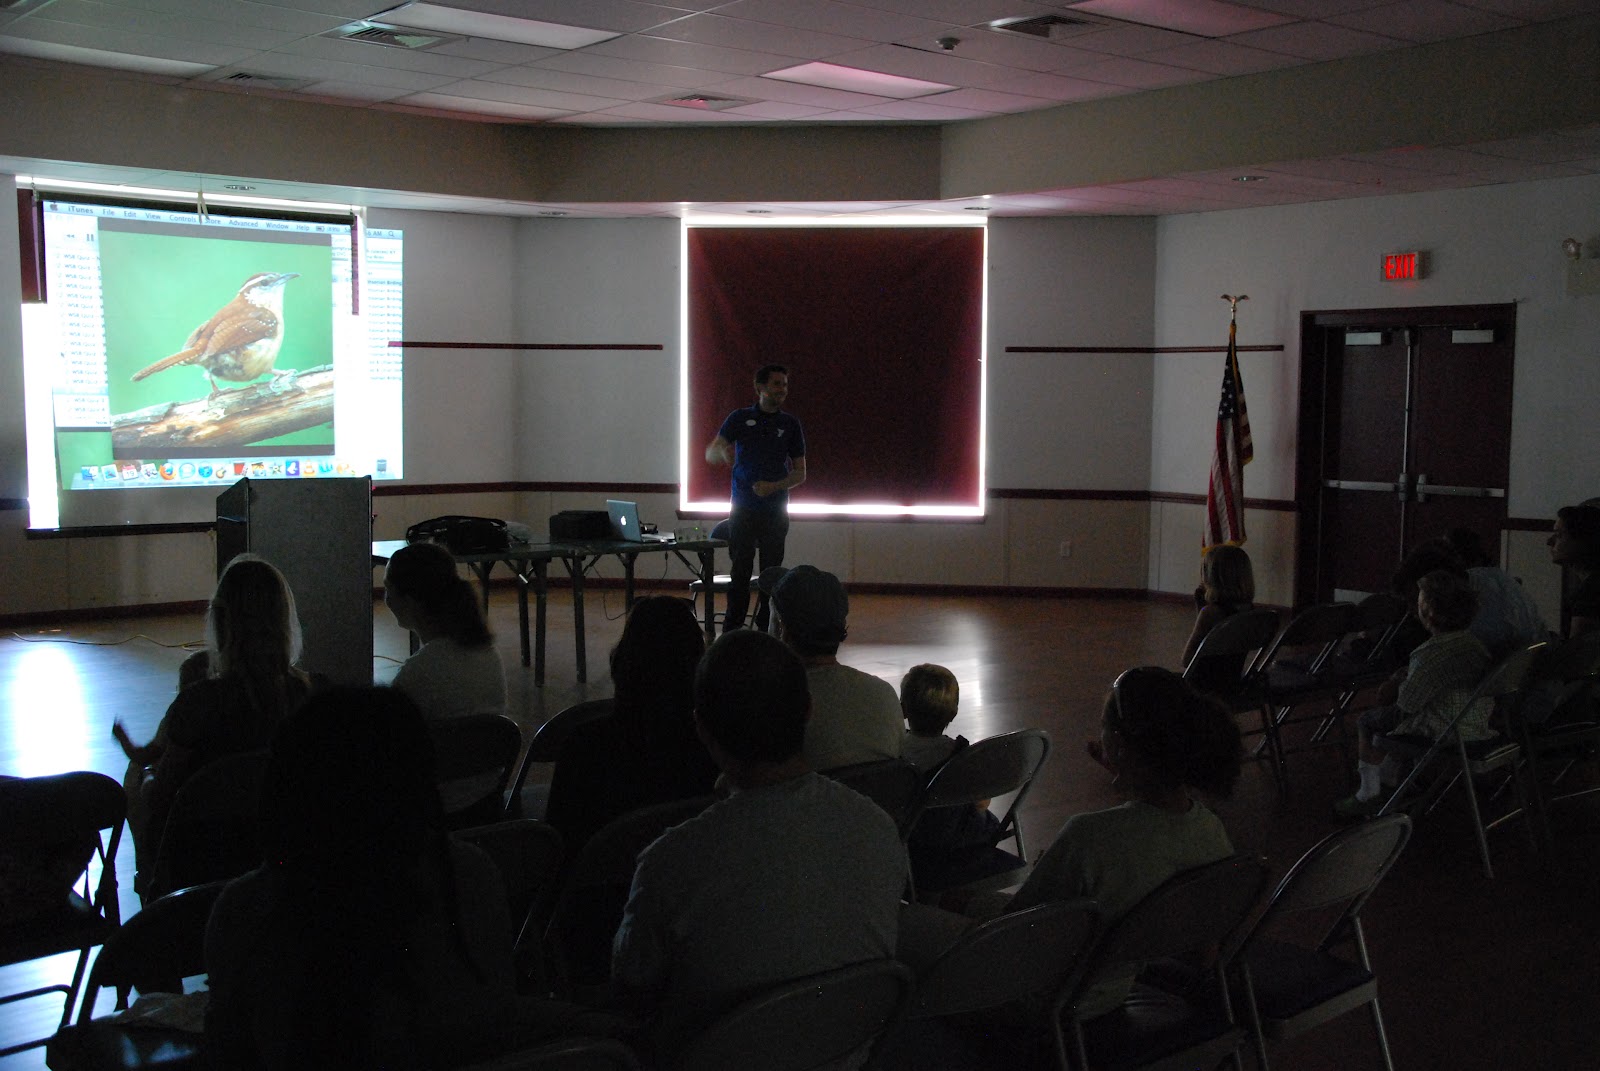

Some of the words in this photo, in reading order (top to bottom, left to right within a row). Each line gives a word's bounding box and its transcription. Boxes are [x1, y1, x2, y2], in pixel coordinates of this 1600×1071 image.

[68, 206, 94, 214] iTunes
[102, 208, 115, 216] File
[124, 210, 136, 218] Edit
[145, 212, 161, 220] View
[169, 214, 196, 223] Controls
[228, 219, 259, 228] Advanced
[1385, 253, 1416, 280] EXIT
